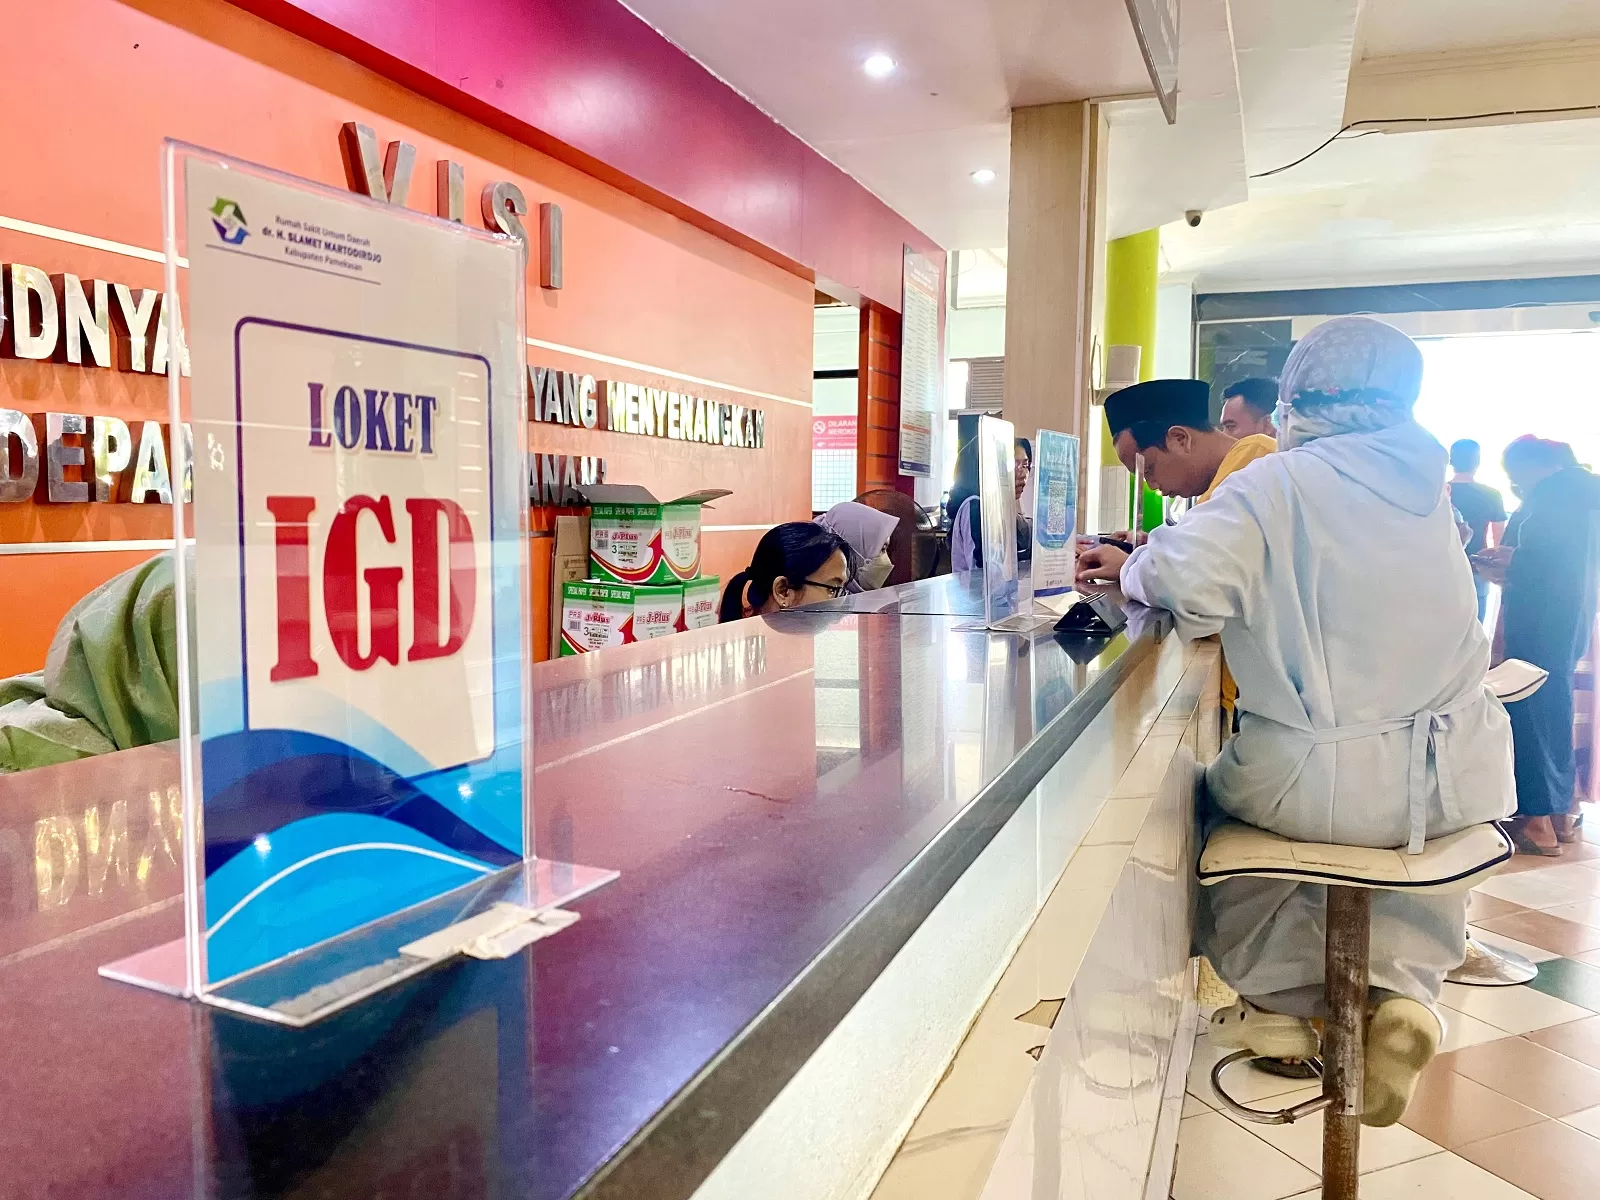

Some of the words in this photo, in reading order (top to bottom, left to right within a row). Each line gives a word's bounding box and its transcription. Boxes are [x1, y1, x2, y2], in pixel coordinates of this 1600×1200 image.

[275, 215, 302, 229] Rumah
[303, 222, 320, 235] Sakit
[321, 228, 346, 241] Umum
[346, 233, 371, 247] Daerah
[340, 121, 562, 290] VISI
[262, 226, 275, 238] dr.
[276, 230, 286, 241] H.
[288, 232, 322, 250] SLAMET
[324, 241, 382, 264] MARTODIRDJO
[284, 246, 323, 263] Kabupaten
[324, 255, 362, 272] Pamekasan
[0, 263, 192, 378] DNYA
[307, 382, 436, 454] LOKET
[528, 365, 597, 429] YANG
[606, 379, 765, 449] MENYENANGKAN
[0, 408, 193, 504] DEPA
[611, 544, 618, 554] 3
[266, 494, 477, 682] IGD
[583, 626, 589, 636] 3
